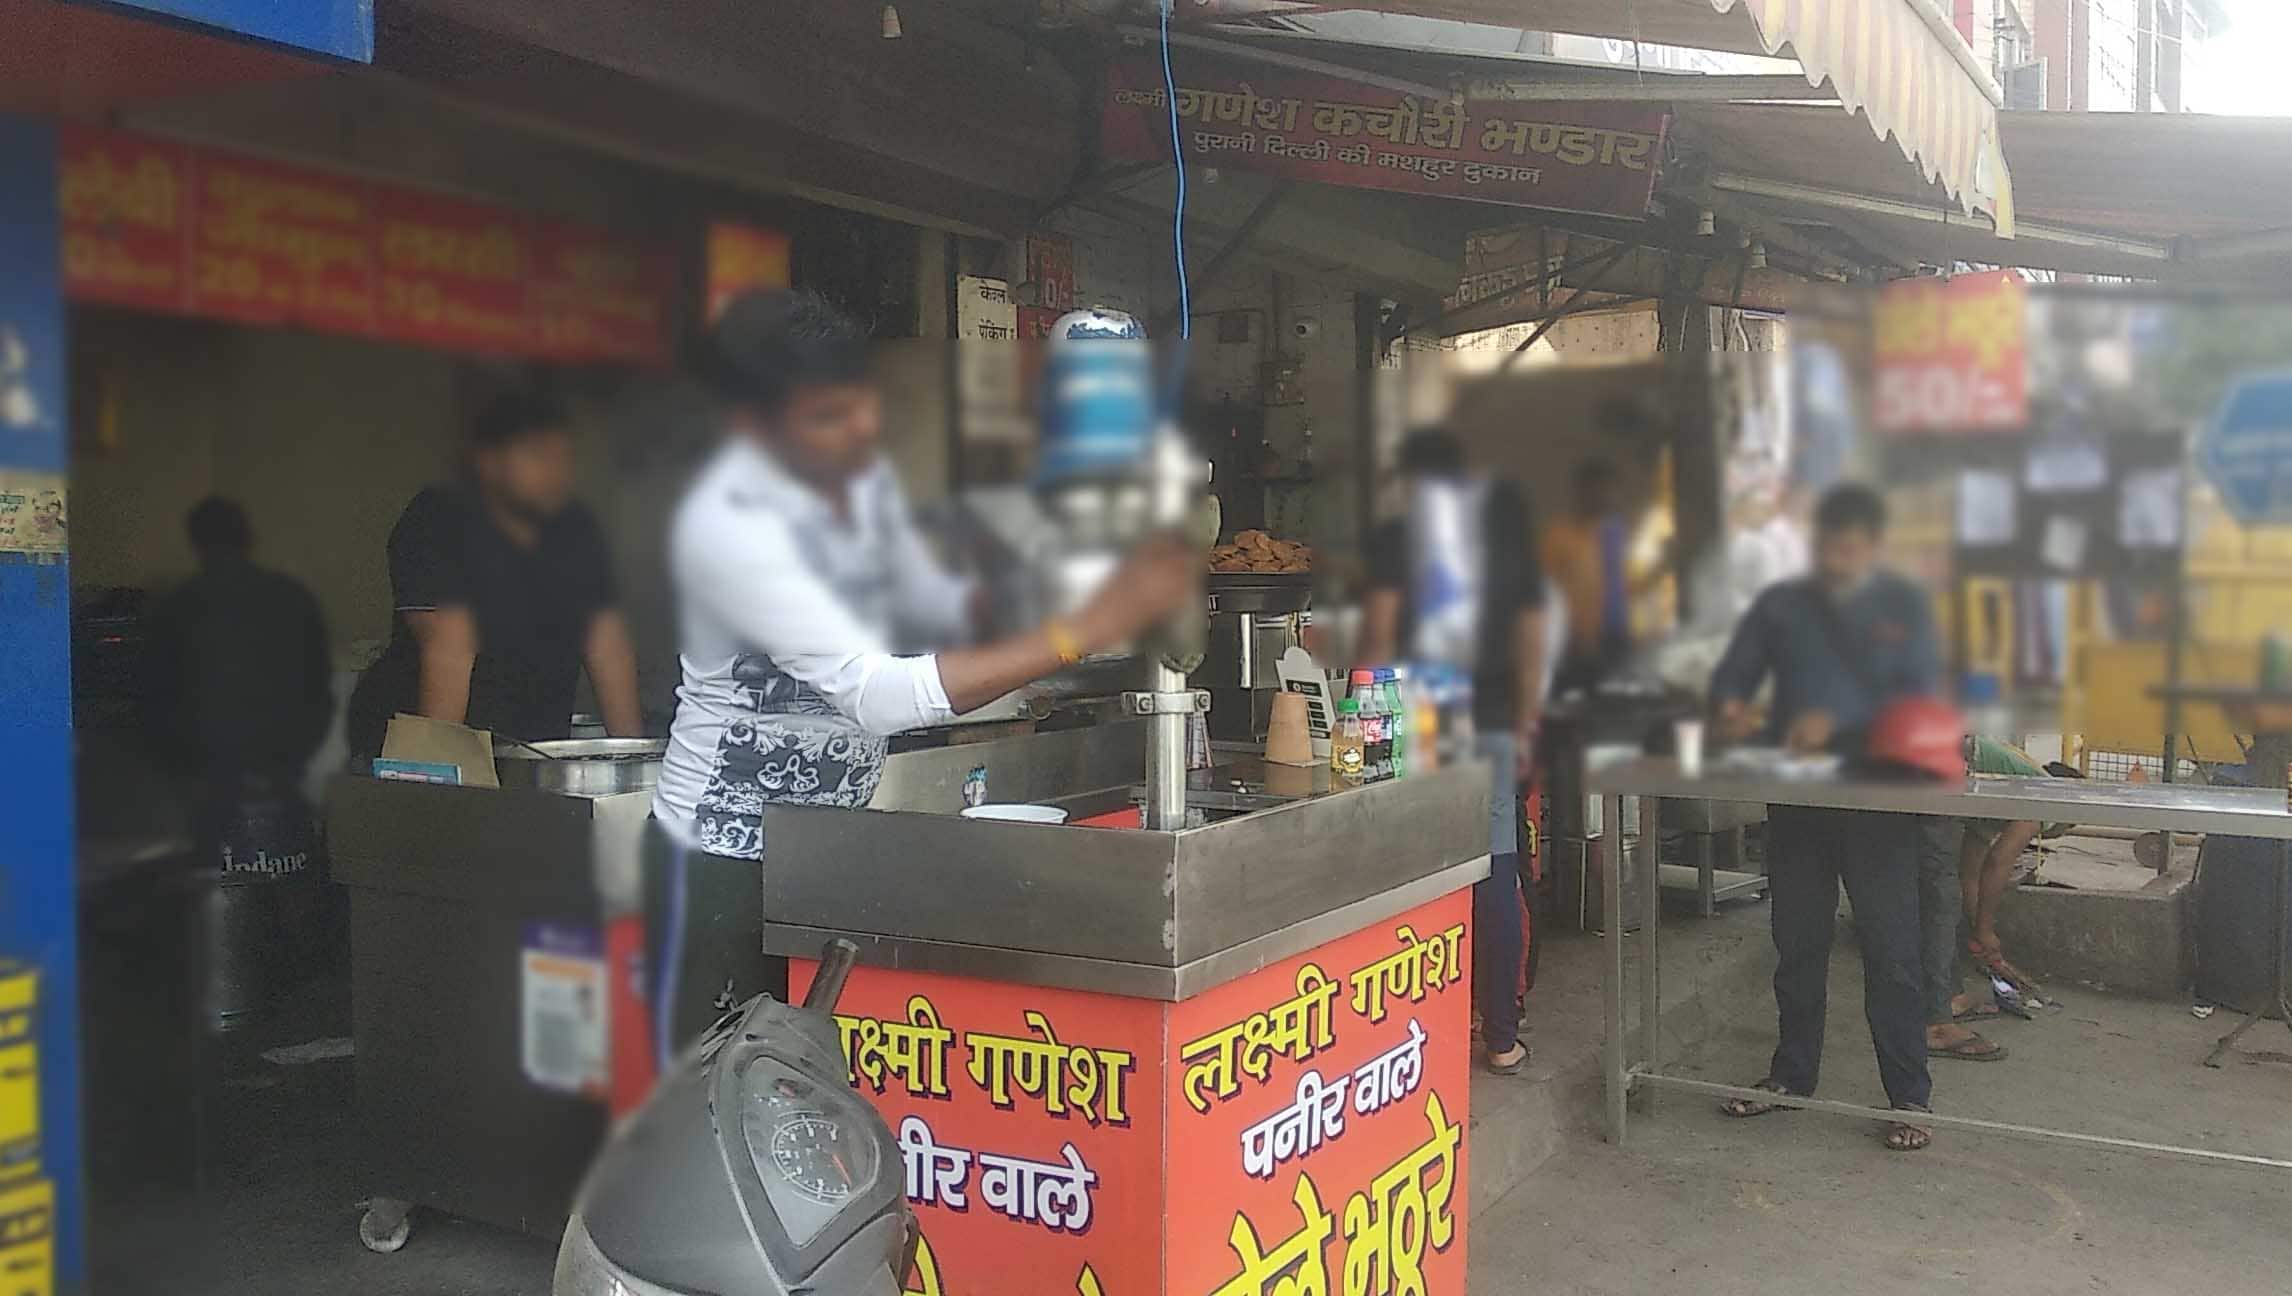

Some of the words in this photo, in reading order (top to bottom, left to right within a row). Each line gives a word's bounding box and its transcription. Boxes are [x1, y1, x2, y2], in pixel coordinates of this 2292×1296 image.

[1176, 82, 1302, 132] गणेश
[1480, 118, 1656, 170] भण्डार
[1193, 129, 1255, 153] पुरानी
[1263, 135, 1330, 162] दिल्ली
[1336, 144, 1370, 166] की
[1463, 161, 1542, 185] दुकान
[965, 1009, 1136, 1127] गणेश
[1180, 963, 1339, 1114] लक्ष्मी
[1350, 924, 1467, 1023] गणेश
[1240, 1070, 1350, 1178] पनीर
[1353, 1018, 1428, 1115] वाले
[978, 1142, 1099, 1235] वाले
